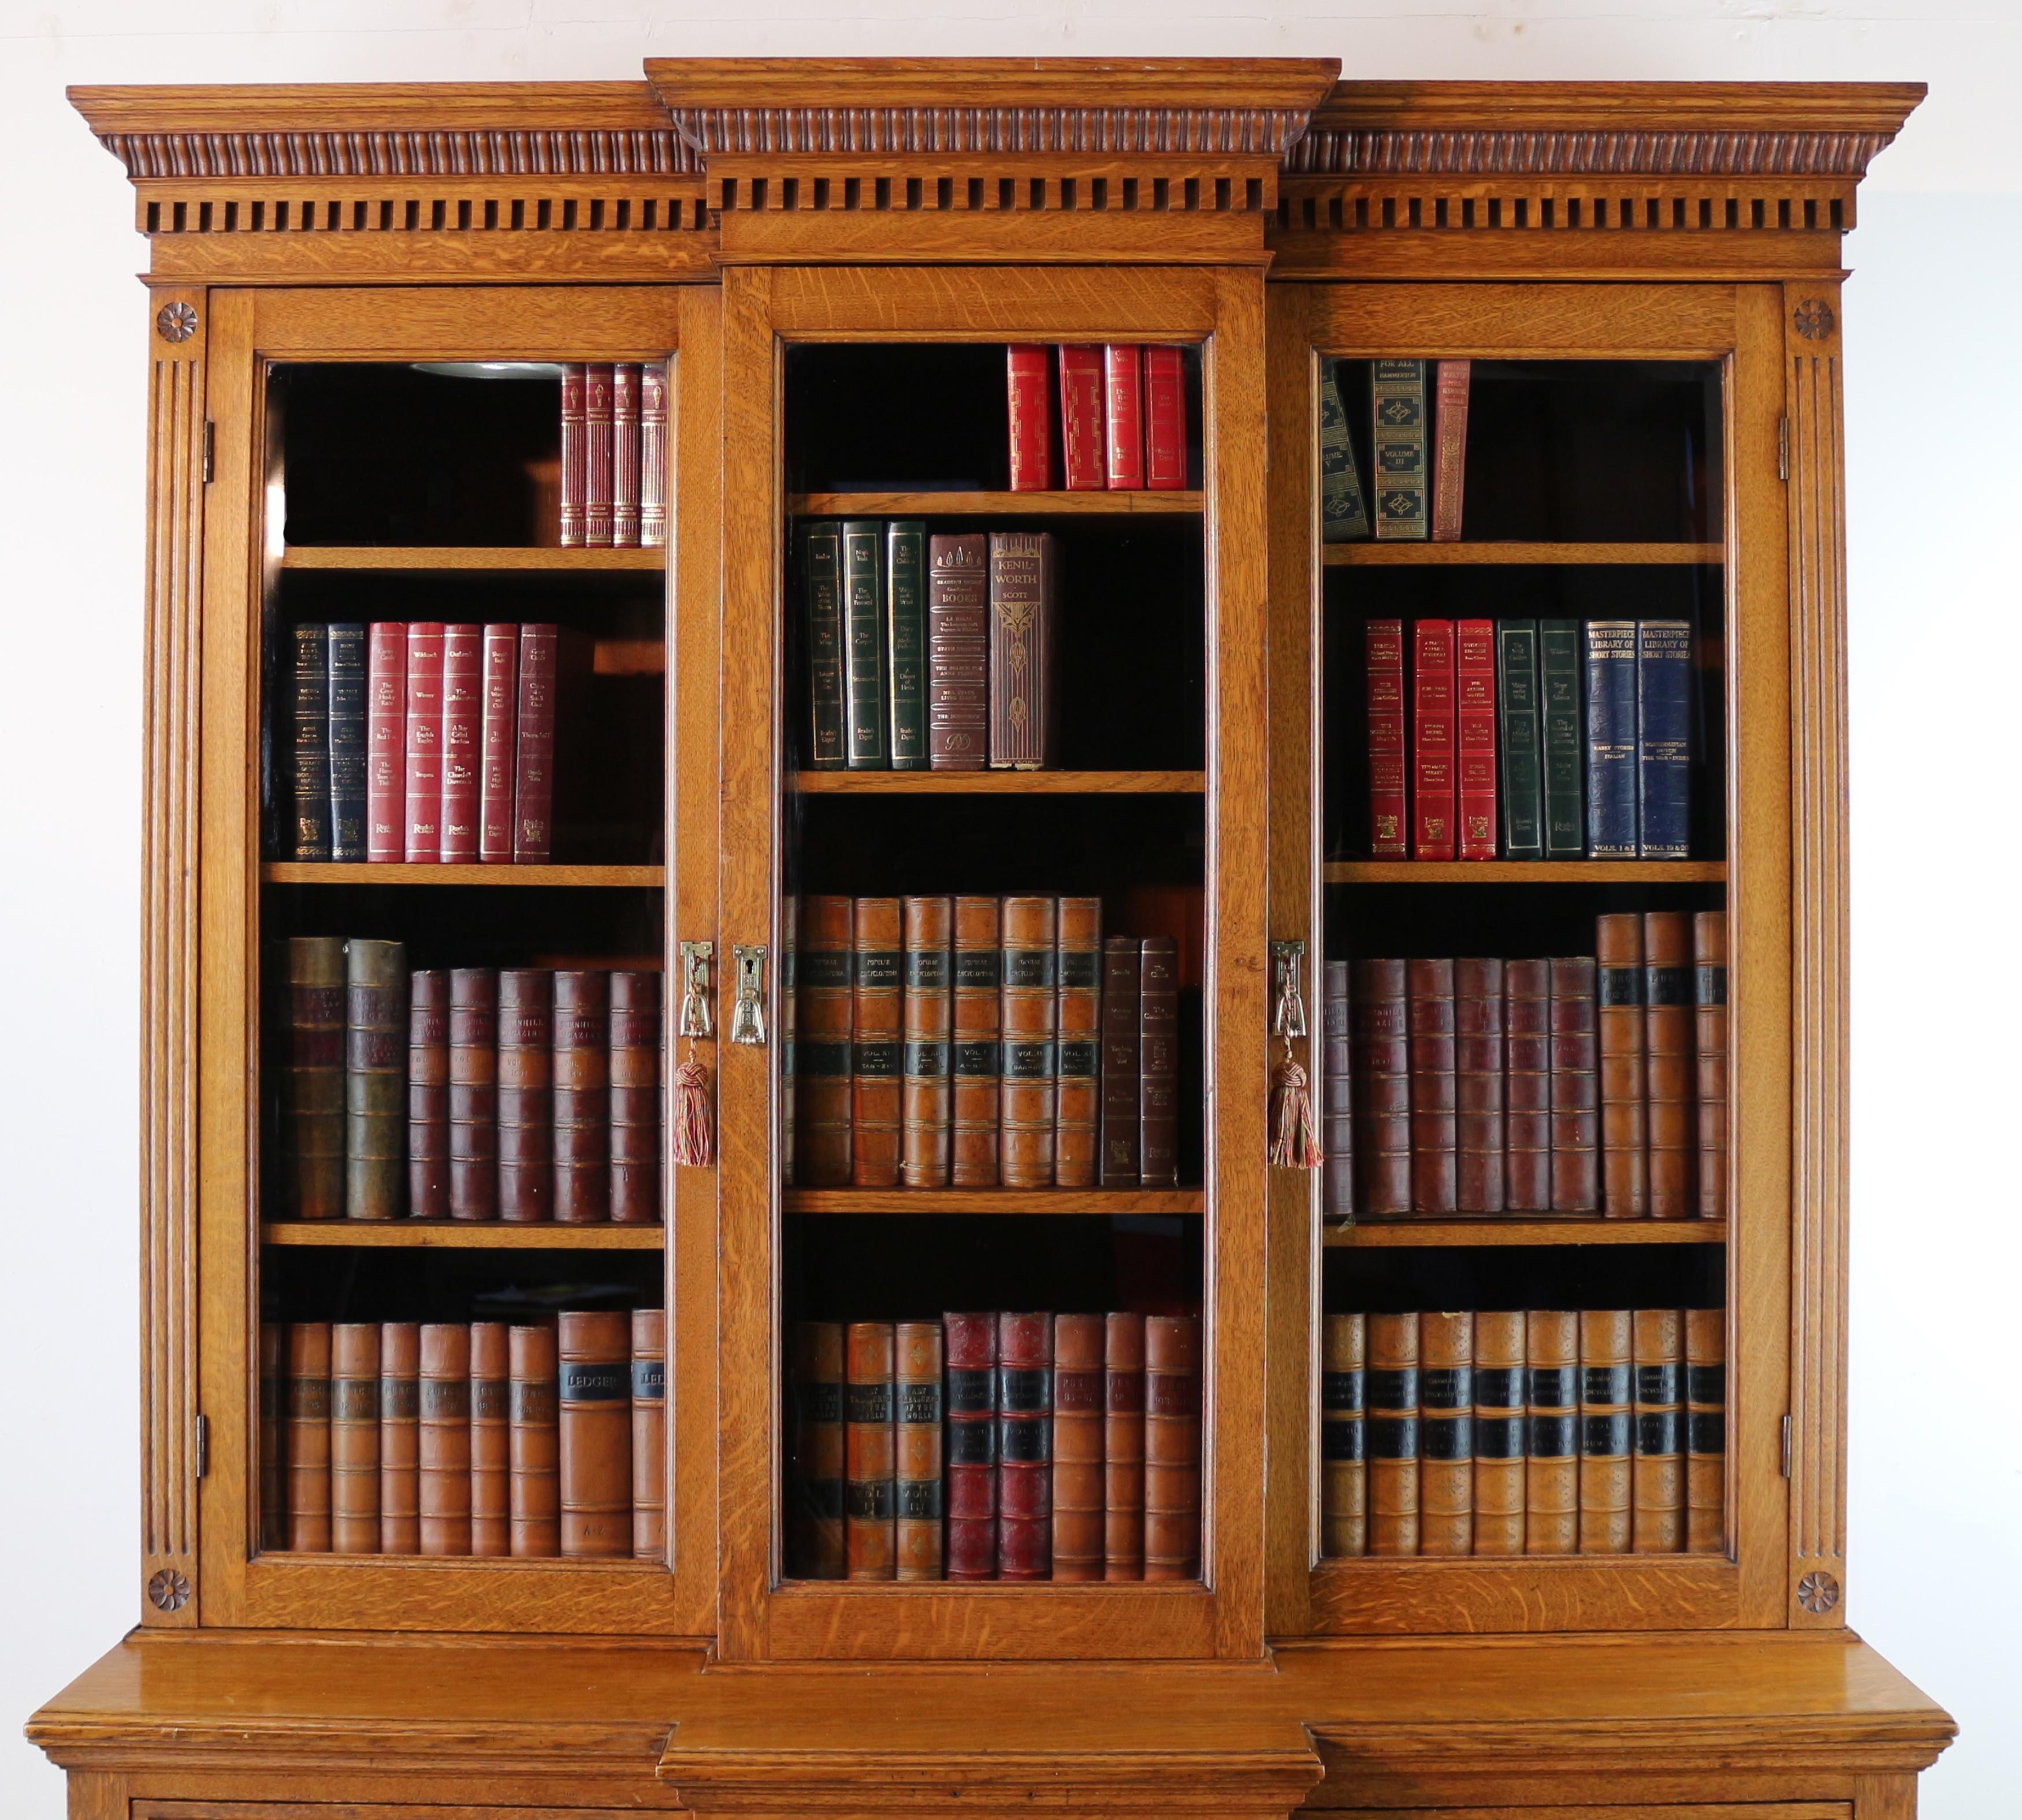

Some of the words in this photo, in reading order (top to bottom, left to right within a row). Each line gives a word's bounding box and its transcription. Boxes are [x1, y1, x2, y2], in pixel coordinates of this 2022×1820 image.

[1322, 452, 1343, 461] LUME
[998, 561, 1034, 570] KENIL-
[995, 575, 1037, 584] WORTH
[942, 594, 977, 602] BOOKS
[1589, 630, 1635, 639] MASTERPIECE
[1643, 630, 1689, 639] MASTERPIECE
[1590, 640, 1623, 649] LIBRARY
[1645, 641, 1678, 649] LIBRARY
[1589, 650, 1610, 658] SHORT
[1611, 650, 1635, 658] STORIES
[1642, 651, 1664, 659] SHORT
[1666, 650, 1690, 658] STORIES
[569, 1375, 618, 1388] LEDGER
[641, 1374, 664, 1386] LED
